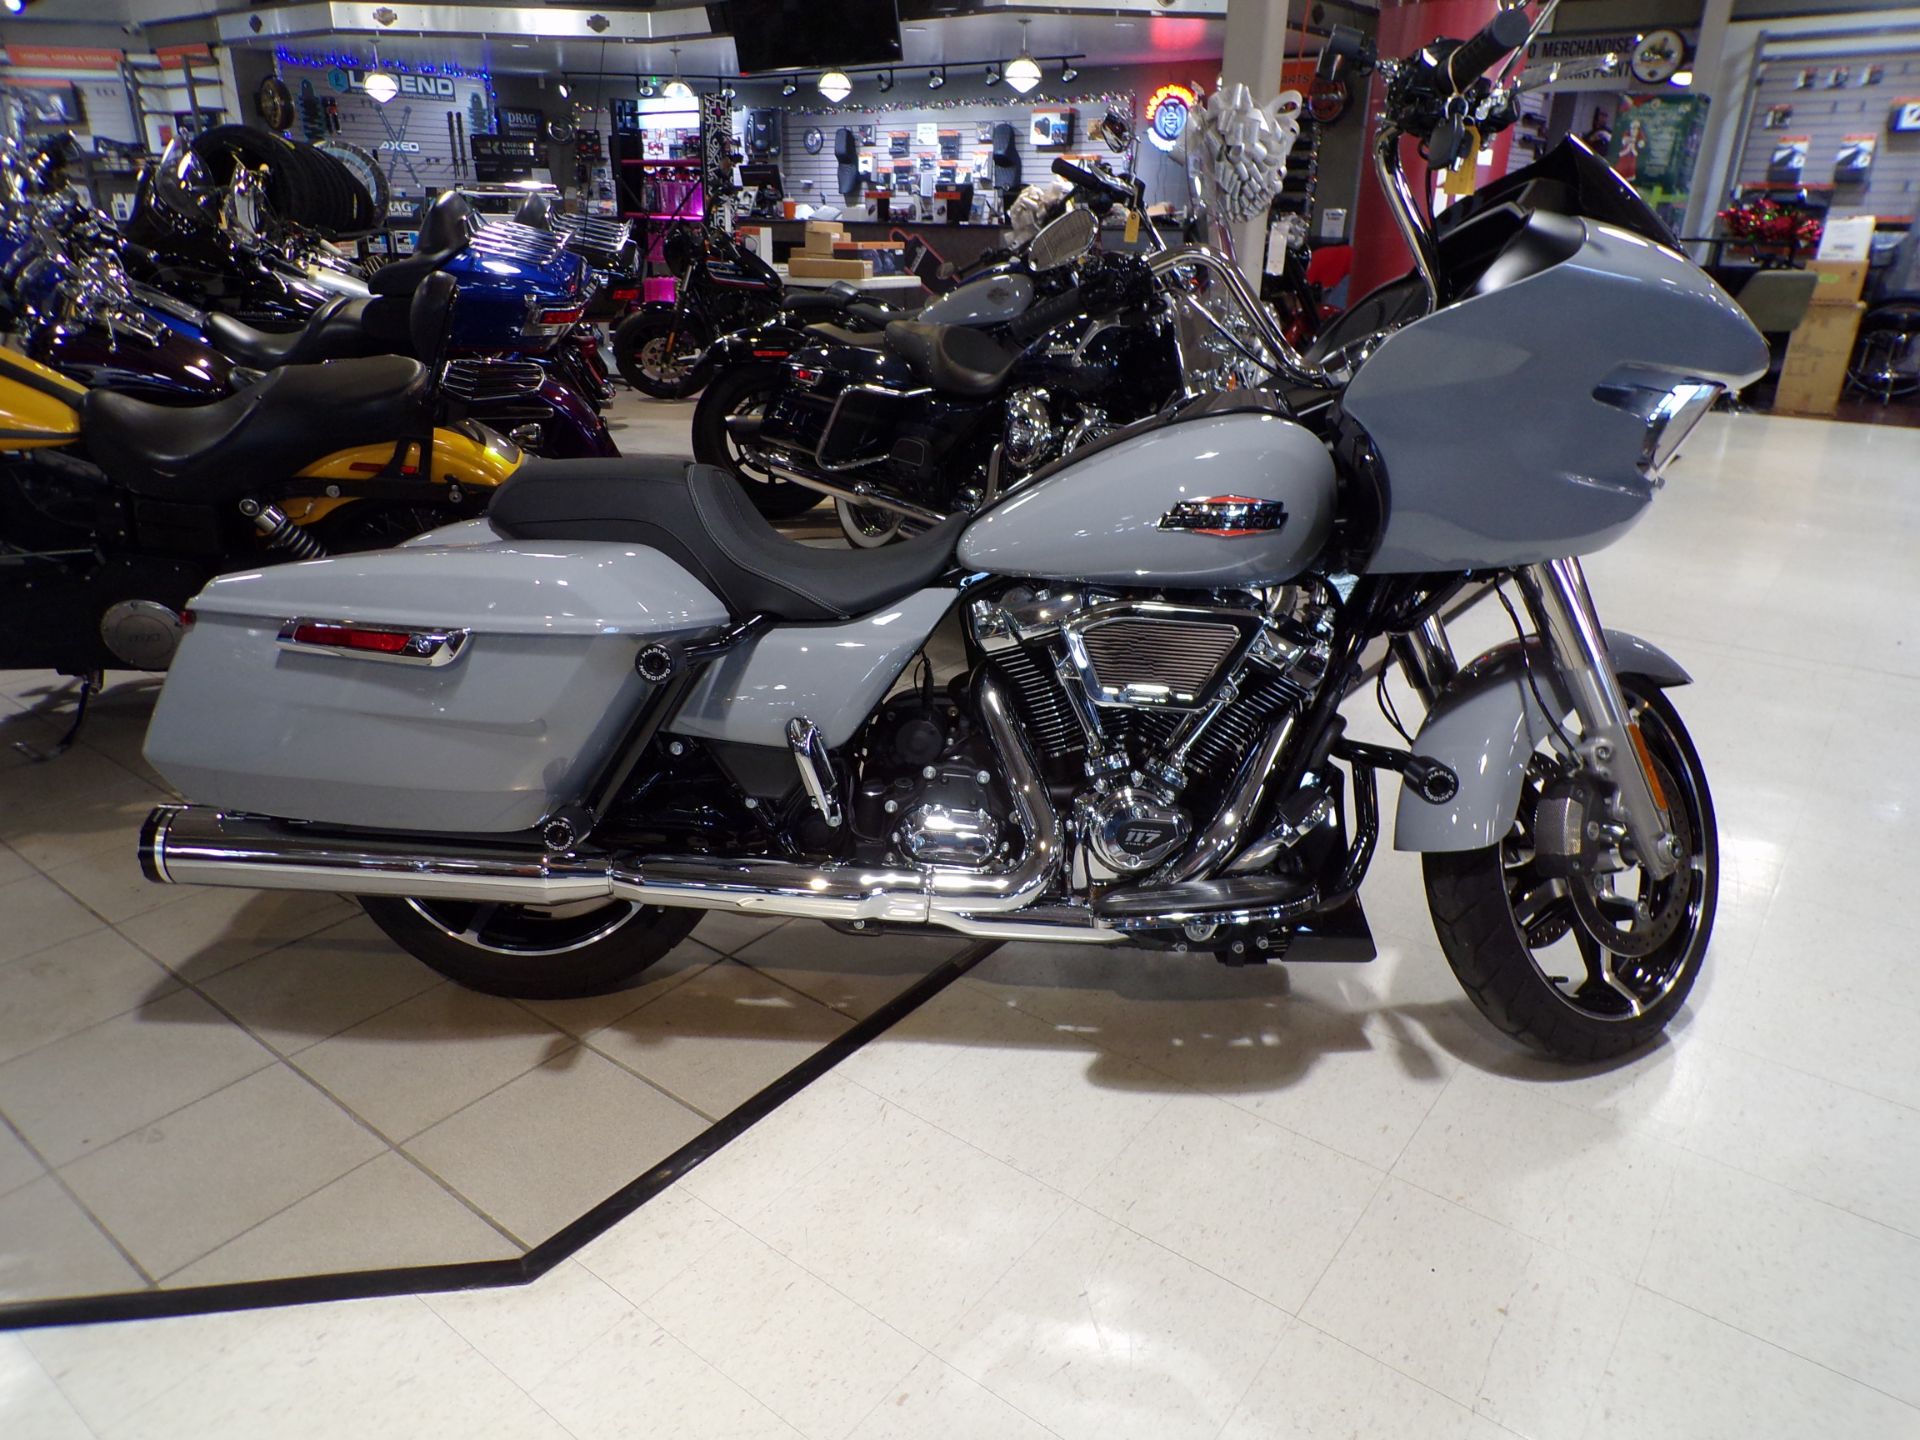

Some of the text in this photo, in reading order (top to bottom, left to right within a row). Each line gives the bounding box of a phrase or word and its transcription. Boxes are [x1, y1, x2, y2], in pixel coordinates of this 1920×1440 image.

[1541, 37, 1633, 57] MERCHANDISE
[347, 70, 455, 95] LEND
[508, 112, 537, 124] DRAG
[1124, 831, 1162, 844] 117
